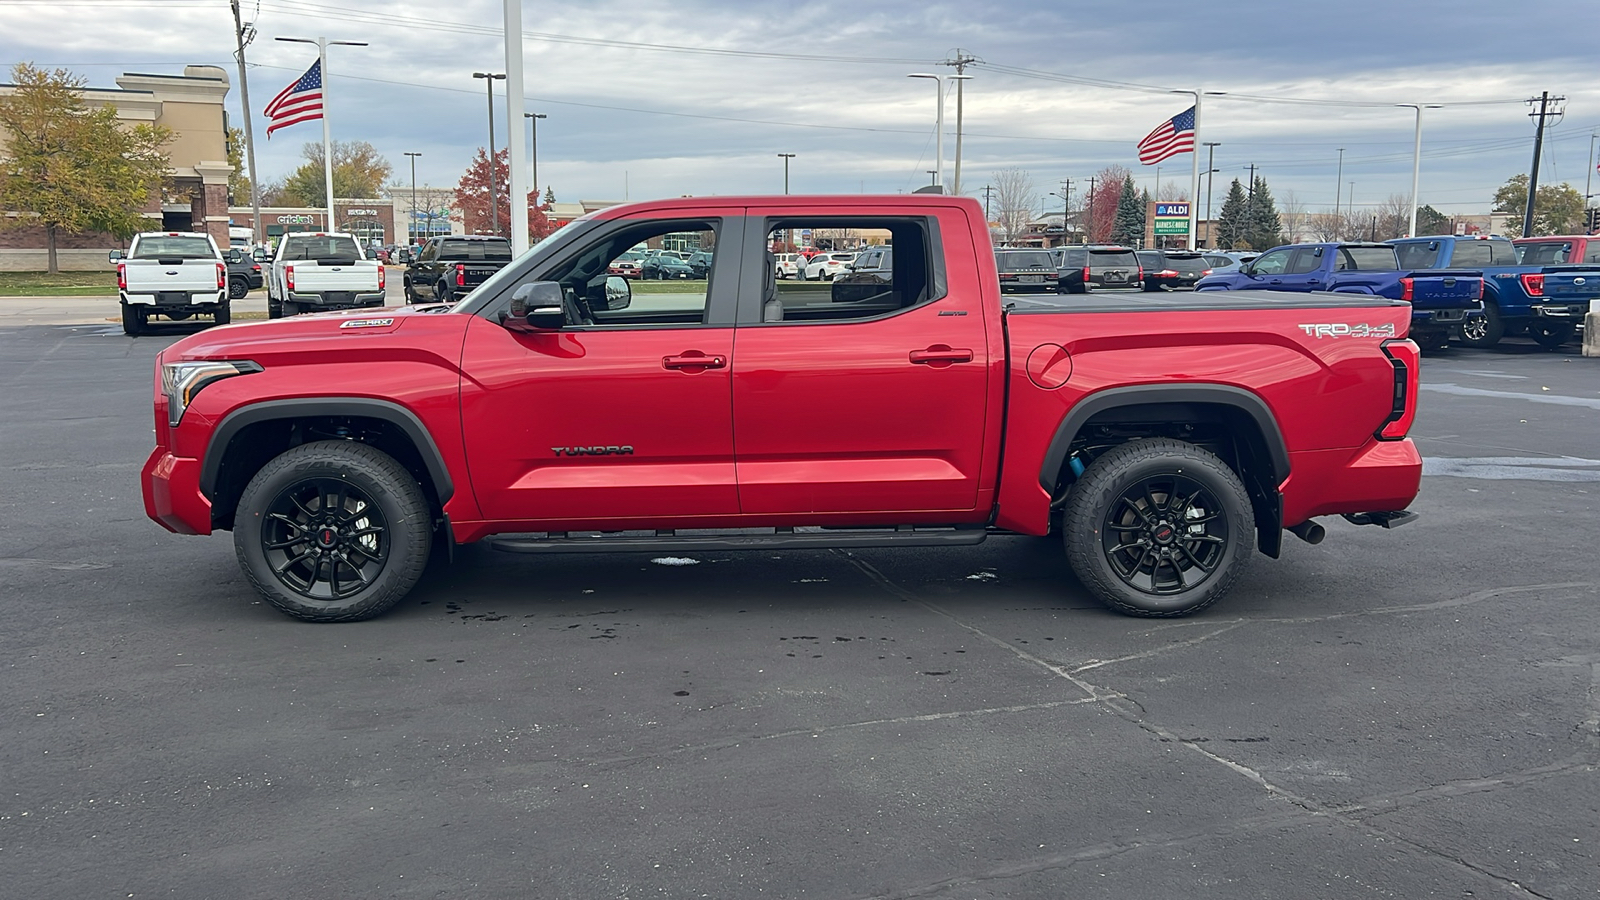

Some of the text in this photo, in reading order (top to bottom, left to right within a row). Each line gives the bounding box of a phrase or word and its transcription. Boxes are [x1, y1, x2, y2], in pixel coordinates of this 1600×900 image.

[1167, 206, 1187, 214] ALDI
[277, 214, 314, 225] cricket
[1298, 324, 1351, 339] TRD
[551, 445, 634, 456] TUNDRA
